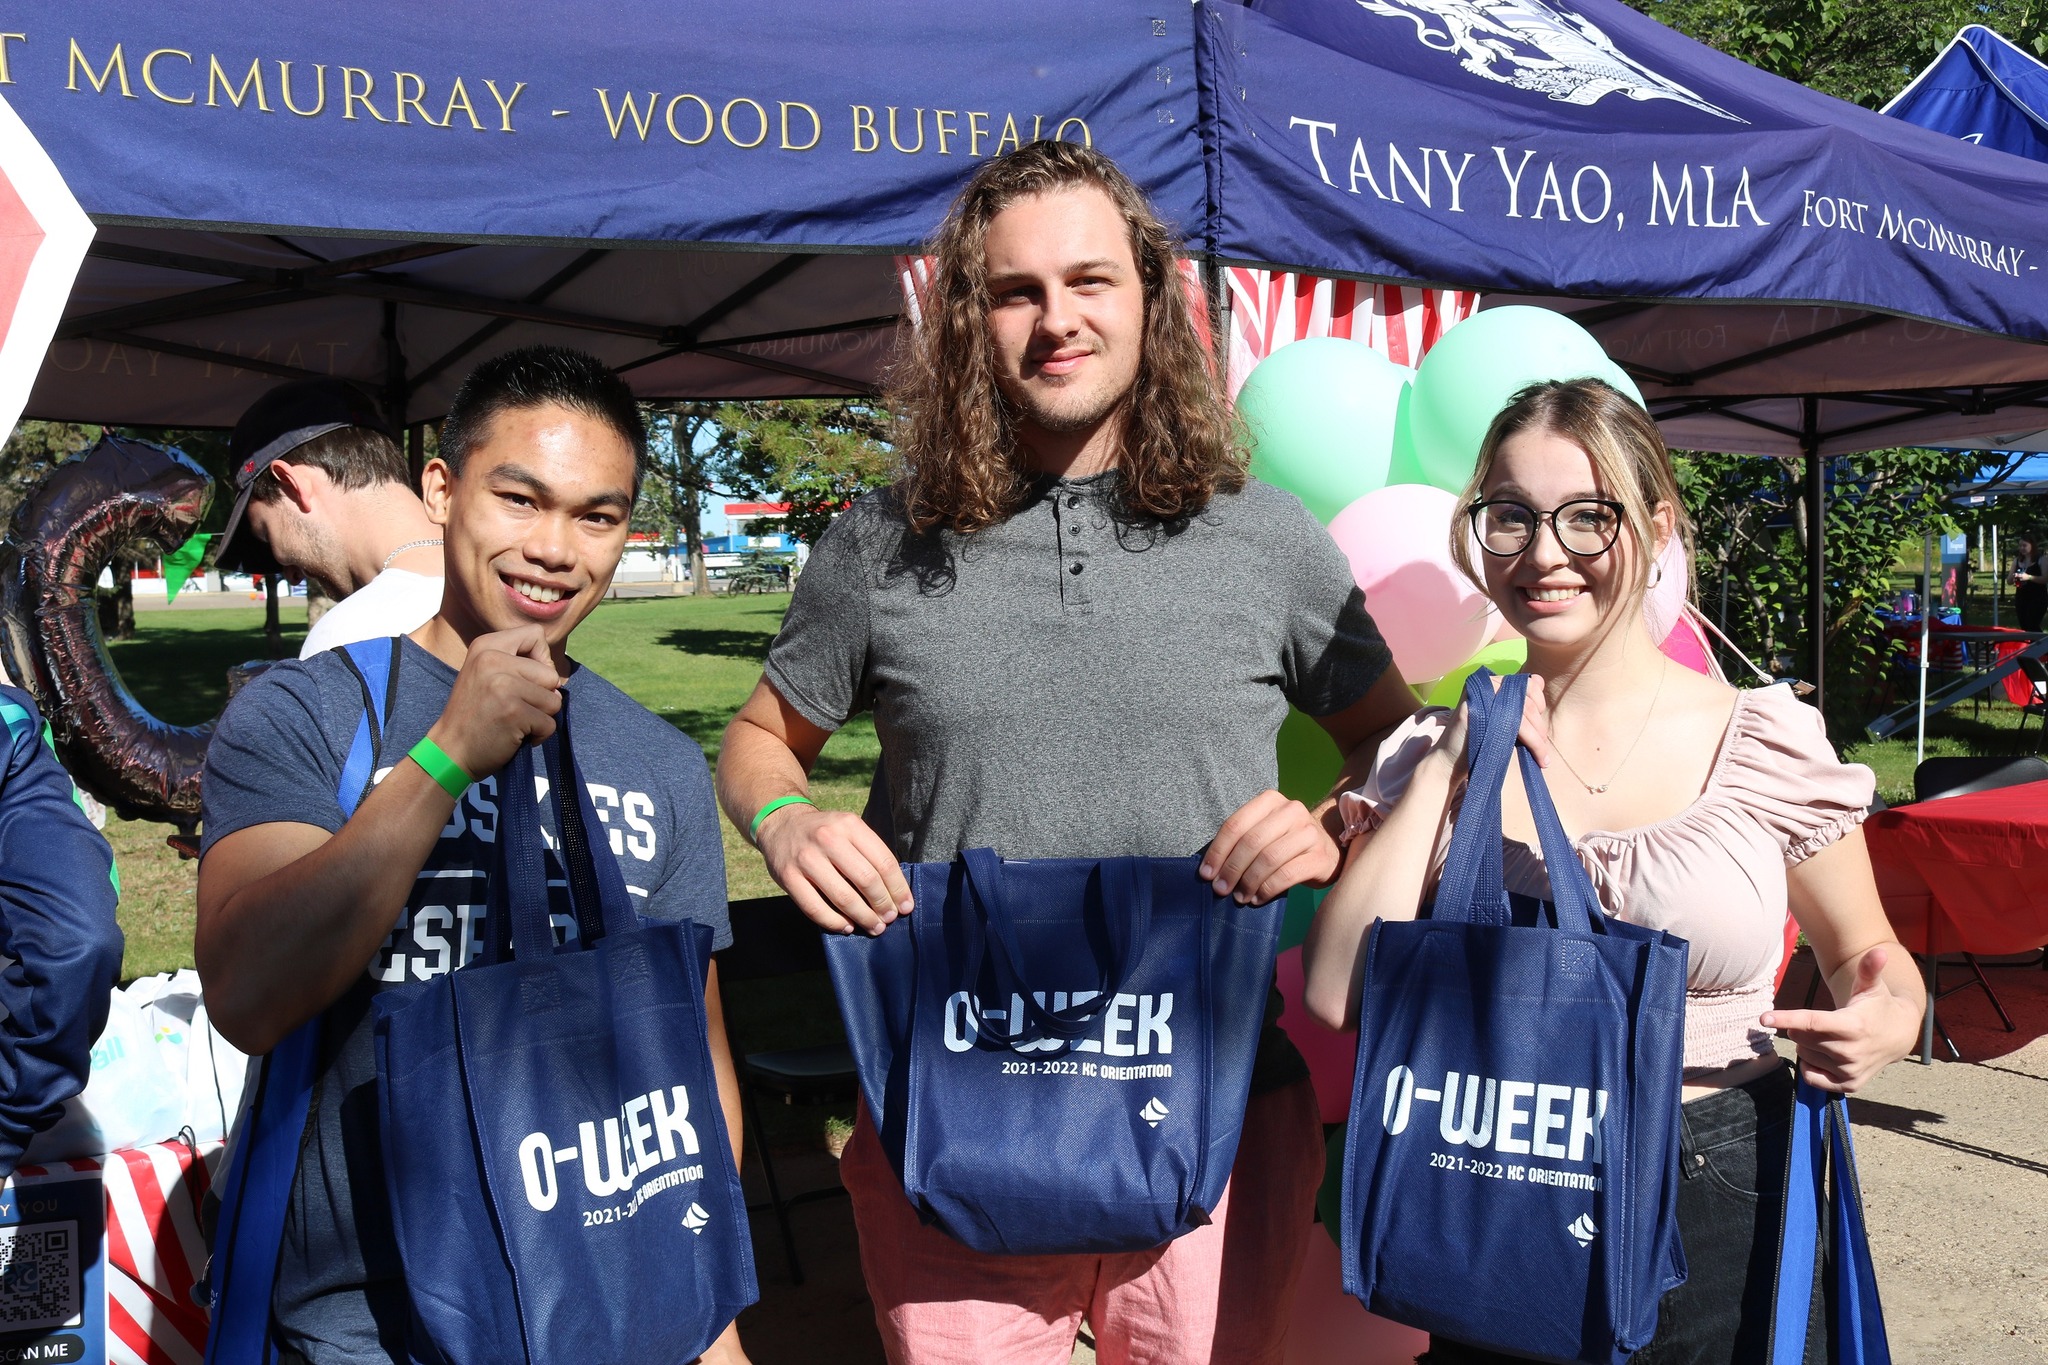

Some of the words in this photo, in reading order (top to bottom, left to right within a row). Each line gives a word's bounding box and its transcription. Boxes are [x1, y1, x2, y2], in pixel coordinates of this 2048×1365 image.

[64, 37, 528, 133] MCMURRAY
[593, 87, 822, 150] WOOD
[1288, 115, 1476, 212] TANY
[1491, 145, 1625, 231] YAO,
[1646, 160, 1771, 228] MLA
[1801, 189, 1869, 233] FORT
[1875, 204, 2025, 277] MCMURRAY
[1001, 1061, 1078, 1075] 2021-2022
[1082, 1062, 1097, 1077] KC
[1100, 1063, 1172, 1081] ORIENTATION
[1382, 1064, 1609, 1165] O-WEEK
[641, 1164, 704, 1200] ORIENTATION
[1429, 1152, 1503, 1179] 2021-2022
[1507, 1165, 1525, 1182] KC
[1527, 1167, 1603, 1192] ORIENTATION
[19, 1199, 59, 1216] YOU
[0, 1345, 39, 1363] SCAN
[44, 1342, 69, 1359] ME
